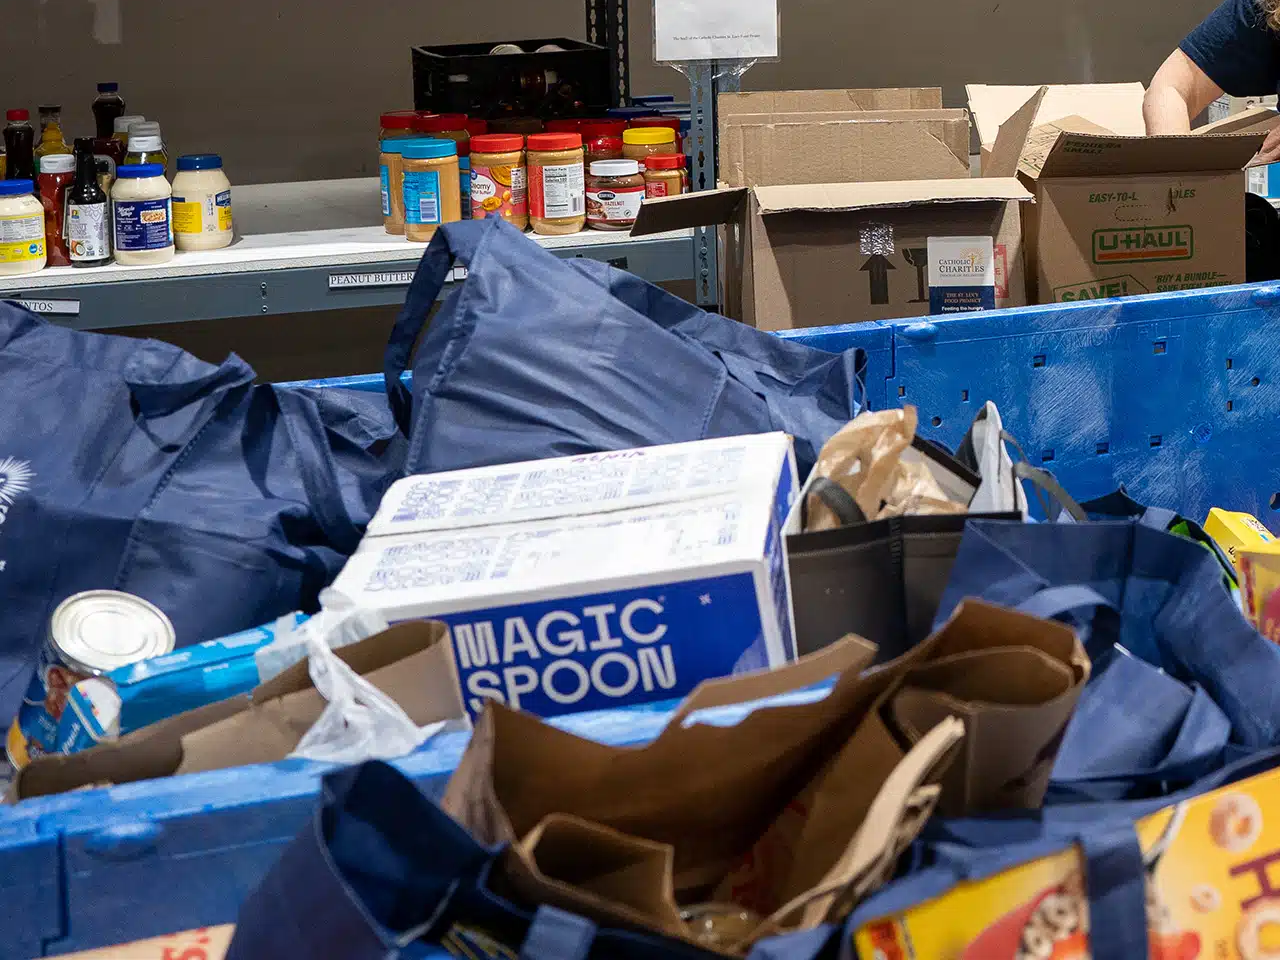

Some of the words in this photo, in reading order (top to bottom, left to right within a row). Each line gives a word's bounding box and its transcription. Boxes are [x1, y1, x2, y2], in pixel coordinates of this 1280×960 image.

[1088, 192, 1138, 203] EASY-TO-L
[1099, 231, 1187, 250] U-HAUL
[330, 274, 373, 285] PEANUT
[374, 271, 413, 282] BUTTER
[1062, 280, 1128, 302] SAVE!
[453, 598, 669, 669] MAGIC
[467, 645, 677, 713] SPOON
